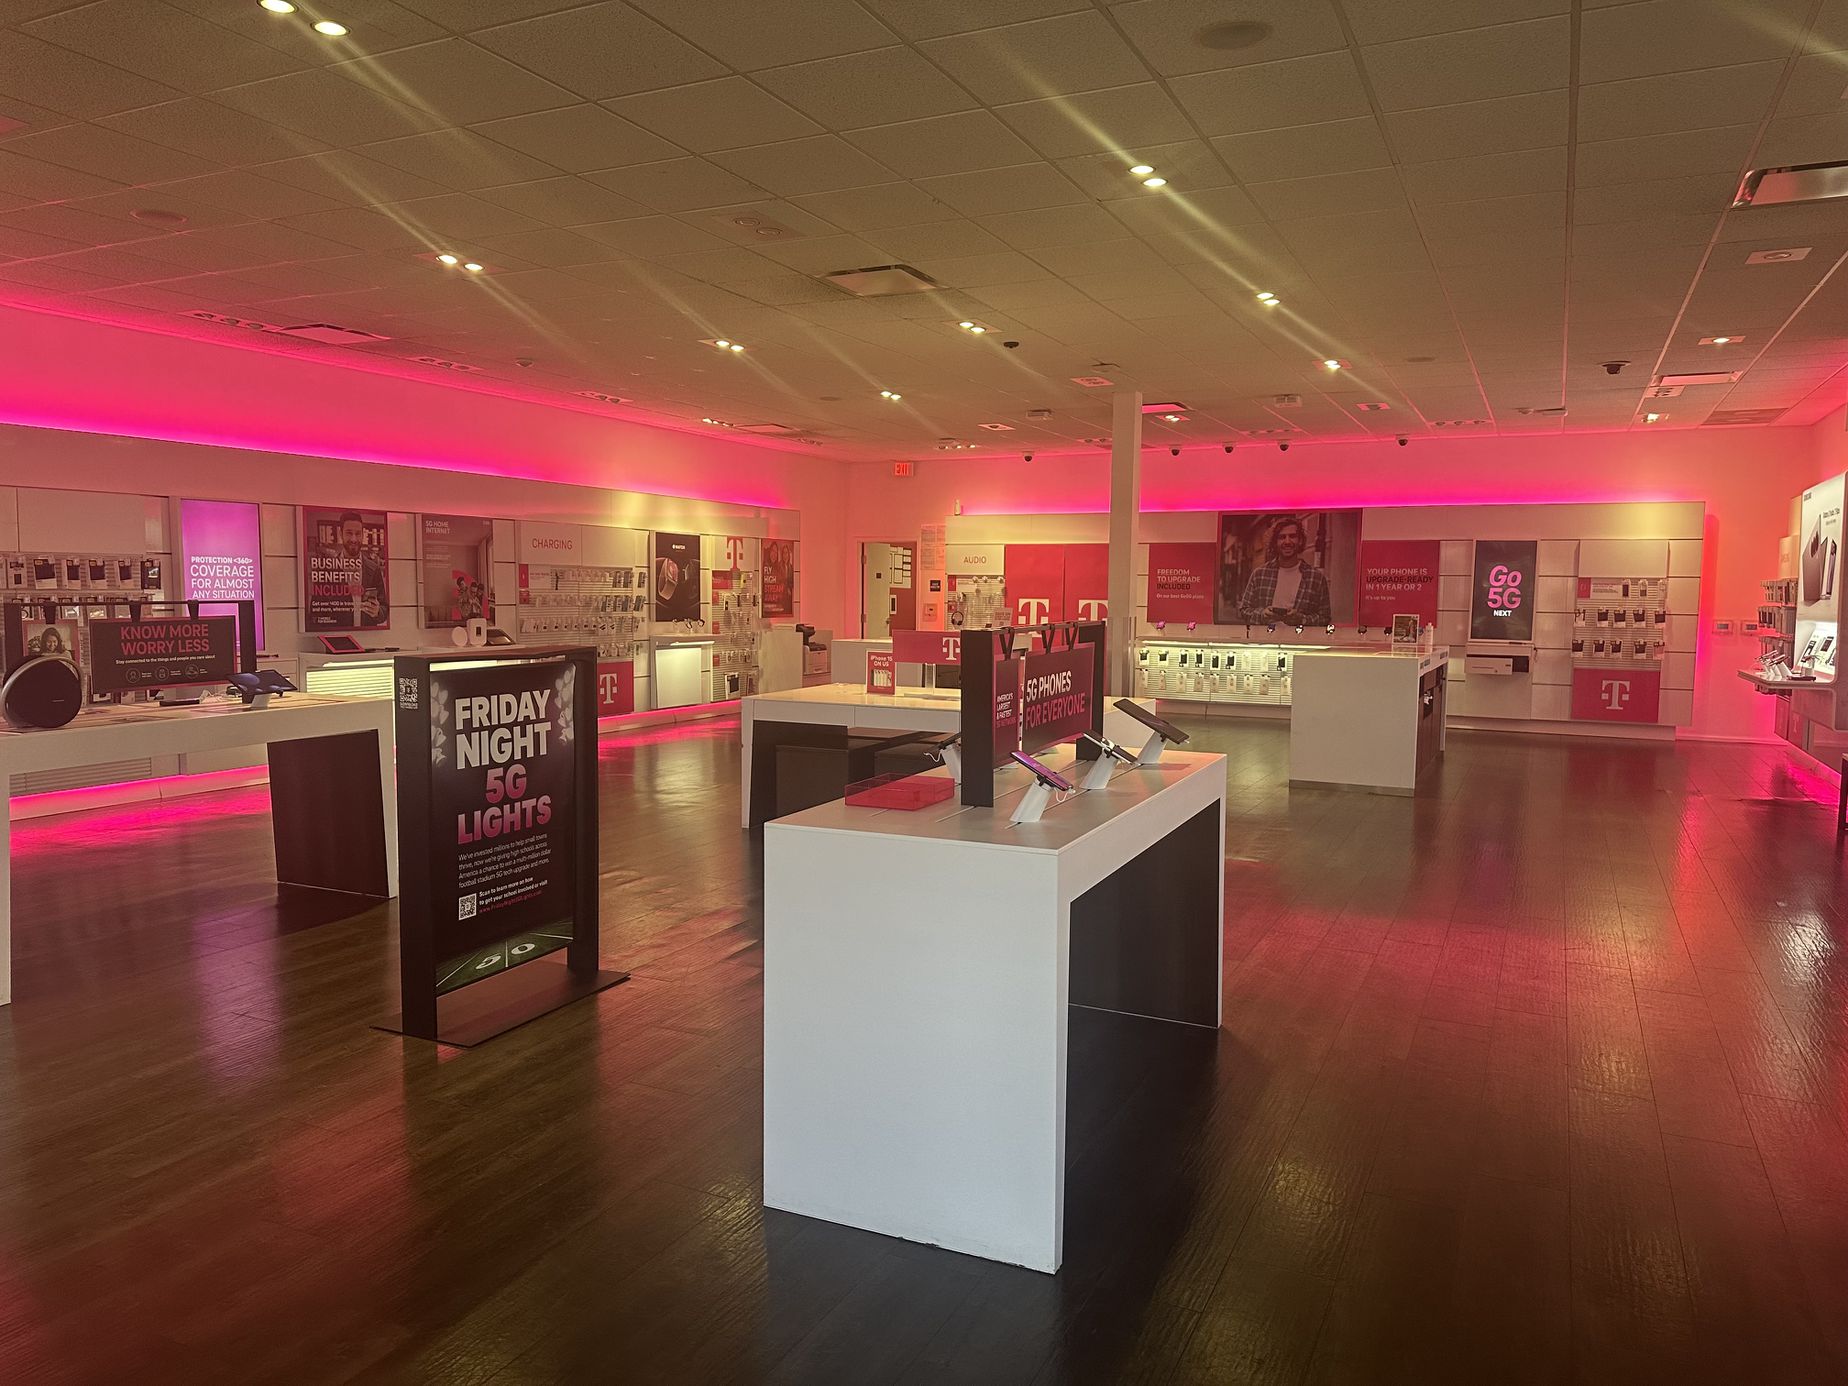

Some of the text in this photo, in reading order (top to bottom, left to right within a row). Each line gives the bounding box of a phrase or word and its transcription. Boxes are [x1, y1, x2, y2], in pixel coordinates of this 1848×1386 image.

[433, 520, 449, 528] HOME
[425, 527, 451, 535] INTERNET
[532, 538, 573, 550] CHARGING
[191, 556, 233, 564] PROTECTION
[311, 557, 362, 570] BUSINESS
[963, 556, 987, 564] AUDIO
[190, 564, 254, 577] COVERAGE
[763, 566, 773, 575] FLY
[1157, 568, 1190, 576] FREEDOM
[1367, 568, 1428, 576] YOUR PHONE IS
[1489, 565, 1522, 588] Go
[311, 571, 361, 583] BENEFITS
[763, 575, 777, 584] HIGH
[1366, 576, 1434, 584] UPGRADE-READY
[191, 579, 254, 589] FOR ALMOST
[311, 584, 365, 596] INCLUDED
[1365, 583, 1374, 591] IN
[1381, 583, 1403, 591] YEAR
[1403, 583, 1416, 591] OR
[1417, 583, 1422, 591] 2
[192, 590, 255, 599] ANY SITUATION
[1487, 587, 1522, 609] 5G
[121, 624, 209, 640] KNOW MORE
[121, 638, 210, 656] WORRY LESS
[943, 637, 961, 661] T
[600, 673, 618, 704] T
[1026, 670, 1072, 703] 5G PHONES
[1601, 680, 1631, 710] T
[455, 689, 550, 731] FRIDAY
[1025, 692, 1086, 730] FOR EVERYONE
[456, 721, 552, 770] NIGHT
[485, 763, 528, 804] 5G
[457, 795, 552, 845] LIGHTS
[494, 843, 510, 853] millions
[510, 849, 520, 857] high
[482, 864, 499, 873] chance
[458, 877, 477, 888] football
[477, 873, 496, 884] stadium
[495, 870, 503, 878] 5G
[484, 896, 493, 905] get
[492, 893, 504, 903] your
[503, 889, 518, 898] school
[539, 879, 548, 887] visit
